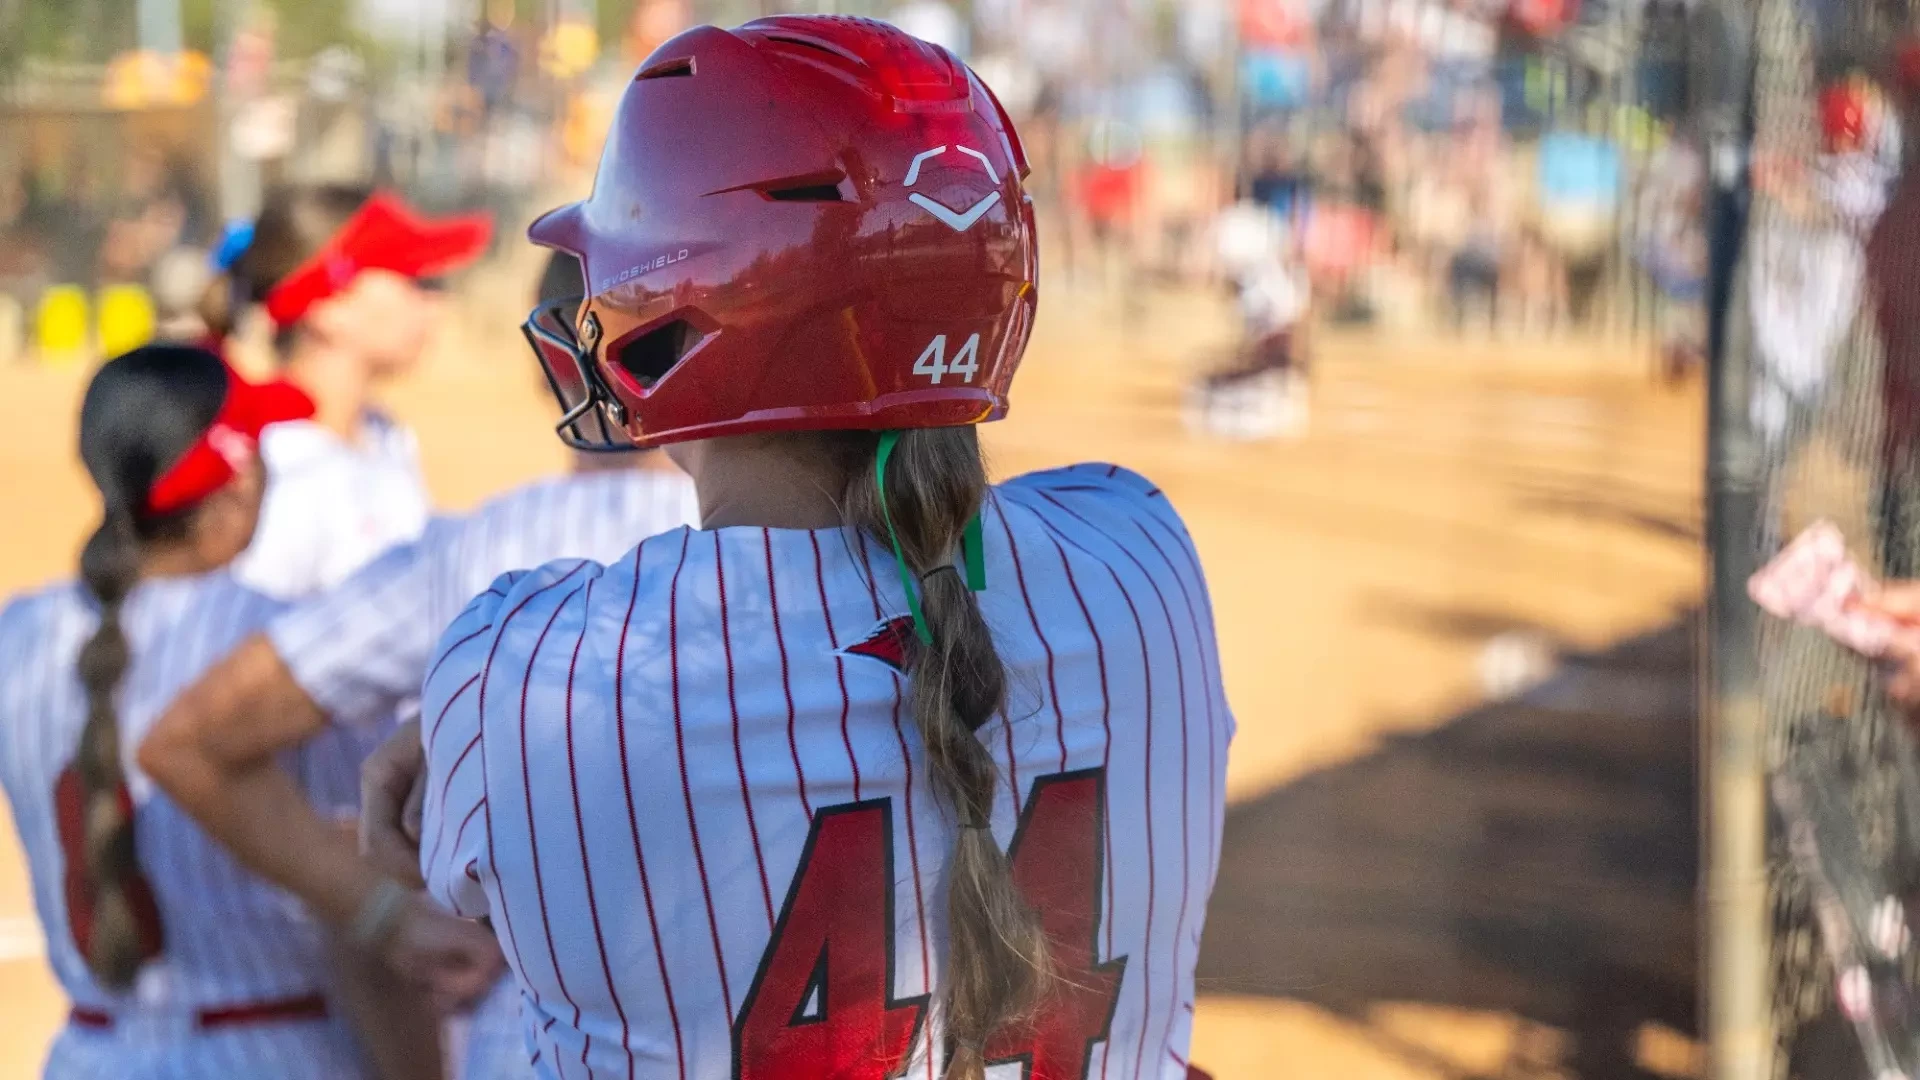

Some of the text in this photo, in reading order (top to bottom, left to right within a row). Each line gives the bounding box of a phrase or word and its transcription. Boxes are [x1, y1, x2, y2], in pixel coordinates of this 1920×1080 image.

[602, 248, 689, 291] EVOSHIELD
[912, 332, 980, 385] 44
[732, 766, 1128, 1080] 44
